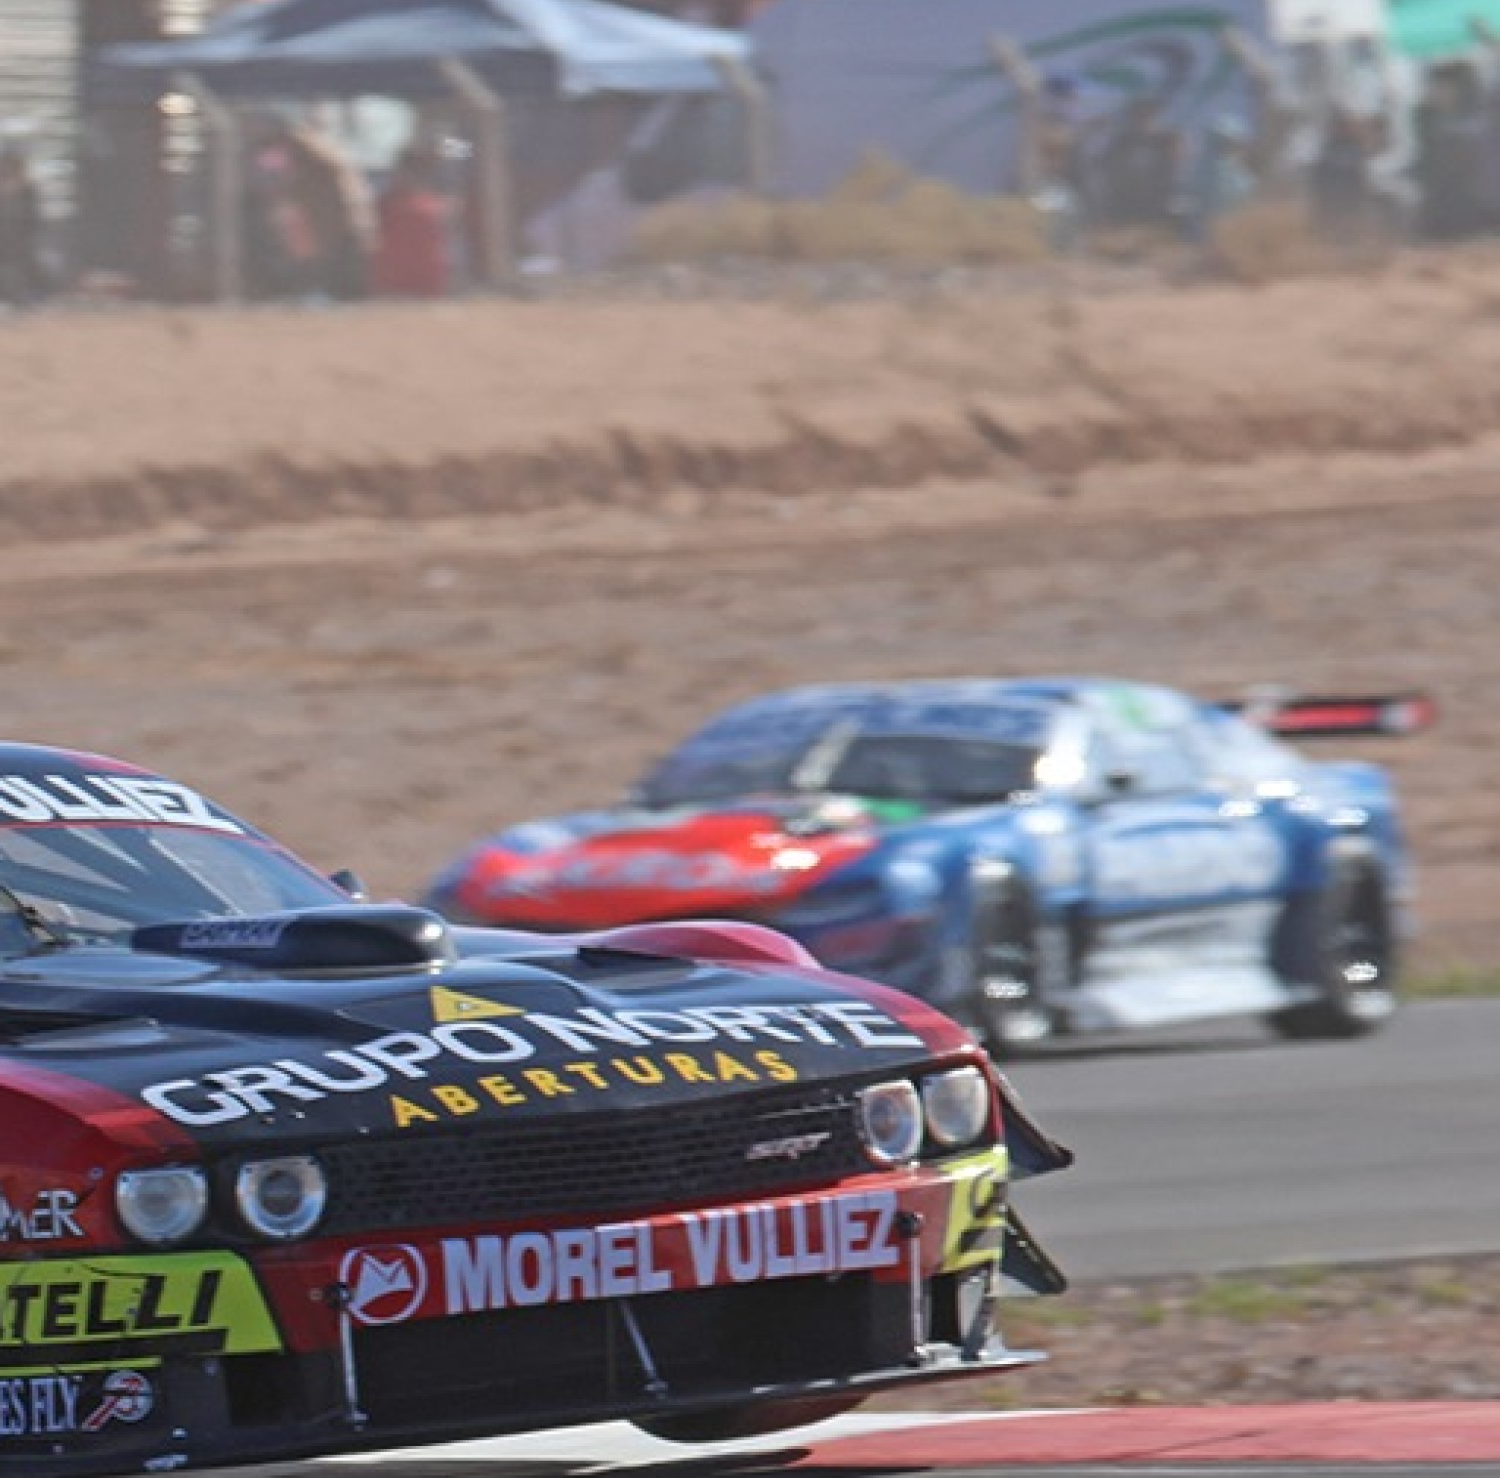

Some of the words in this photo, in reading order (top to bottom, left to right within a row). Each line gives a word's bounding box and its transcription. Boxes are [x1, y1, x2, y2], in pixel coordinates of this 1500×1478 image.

[139, 1020, 534, 1126] GRUPO
[523, 1002, 926, 1052] NORTE
[389, 1049, 799, 1128] ABERTURAS
[440, 1219, 673, 1315] MOREL
[678, 1190, 899, 1287] VULLIEZ
[29, 1376, 82, 1433] FLY
